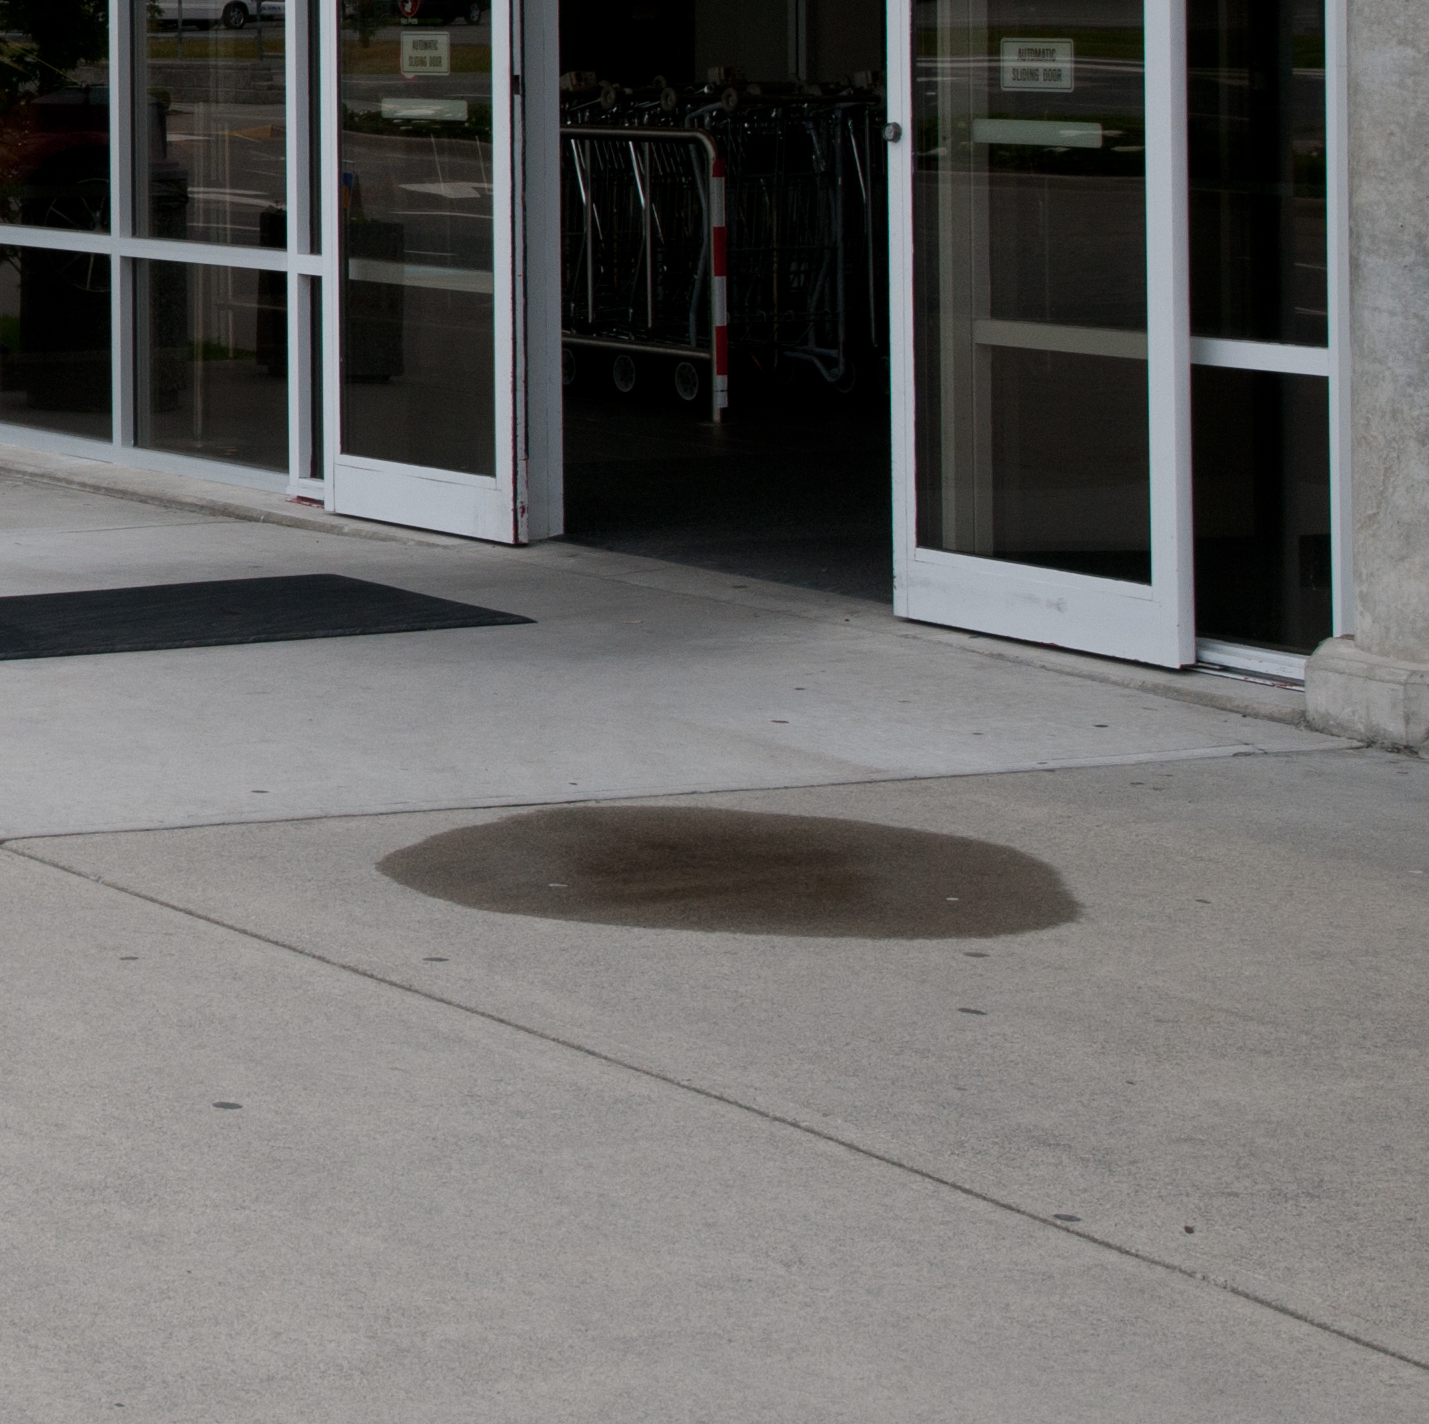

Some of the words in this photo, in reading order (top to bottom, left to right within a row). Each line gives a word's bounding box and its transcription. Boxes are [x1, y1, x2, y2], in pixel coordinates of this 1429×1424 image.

[1016, 48, 1056, 62] AUTOMATIC
[1011, 68, 1039, 81] SLIDING
[1042, 68, 1062, 82] DOOR
